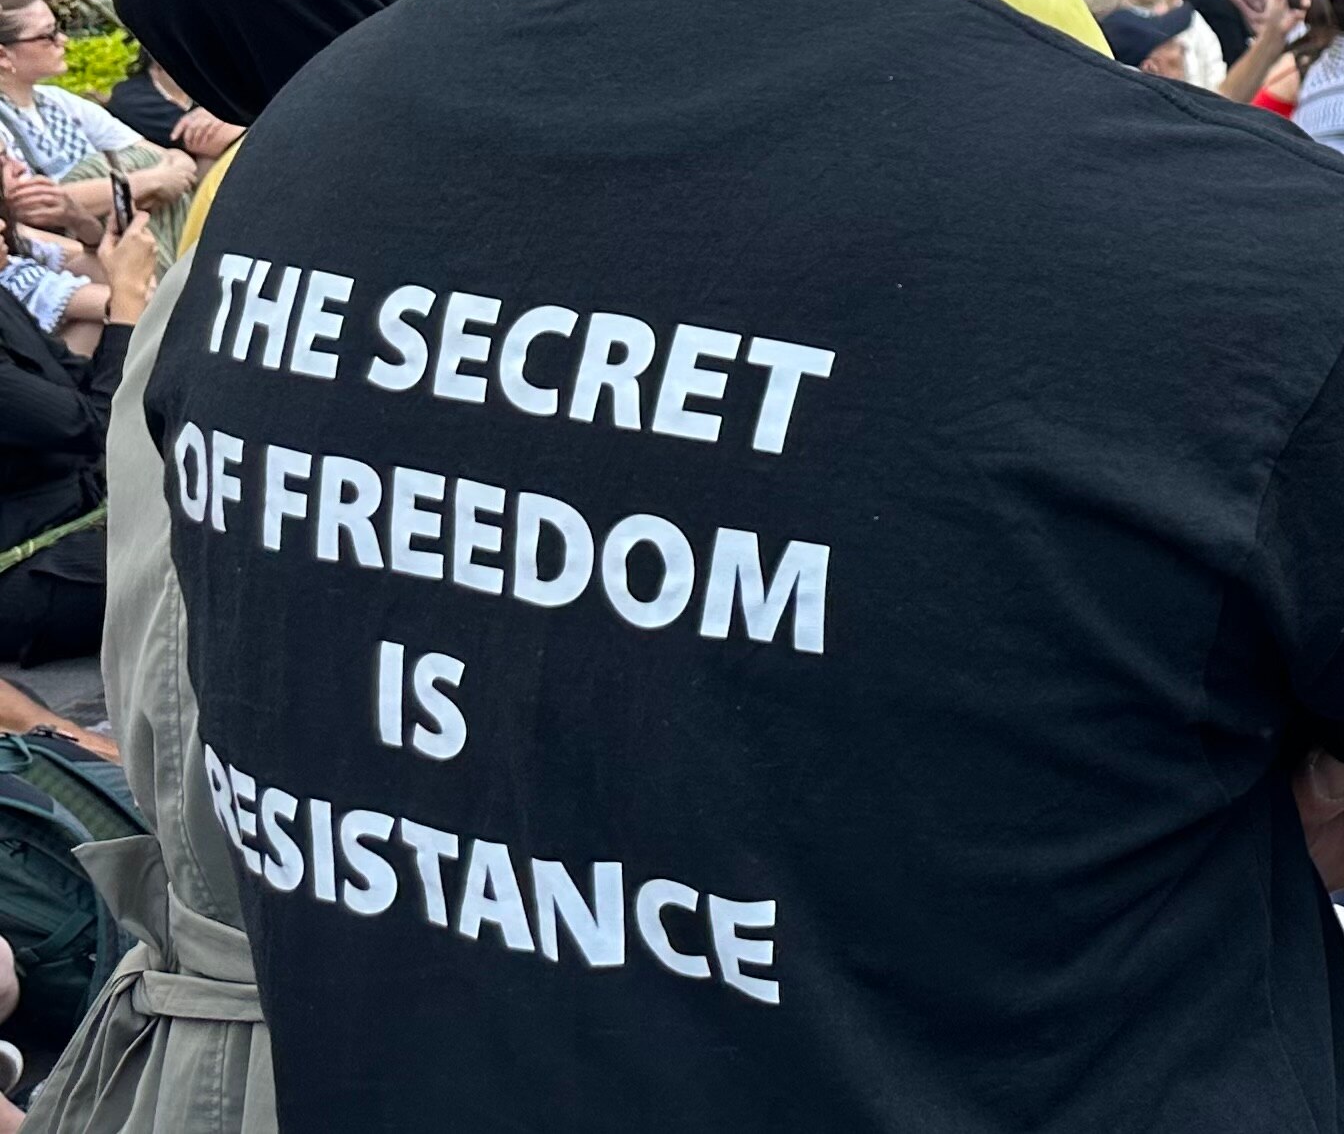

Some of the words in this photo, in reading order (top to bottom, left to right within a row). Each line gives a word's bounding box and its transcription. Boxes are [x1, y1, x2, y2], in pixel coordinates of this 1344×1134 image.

[209, 253, 355, 380] THE
[367, 283, 837, 455] SECRET
[173, 421, 245, 534] OF
[262, 444, 831, 654] FREEDOM
[376, 640, 469, 761] IS
[204, 744, 782, 1005] RESISTANCE
